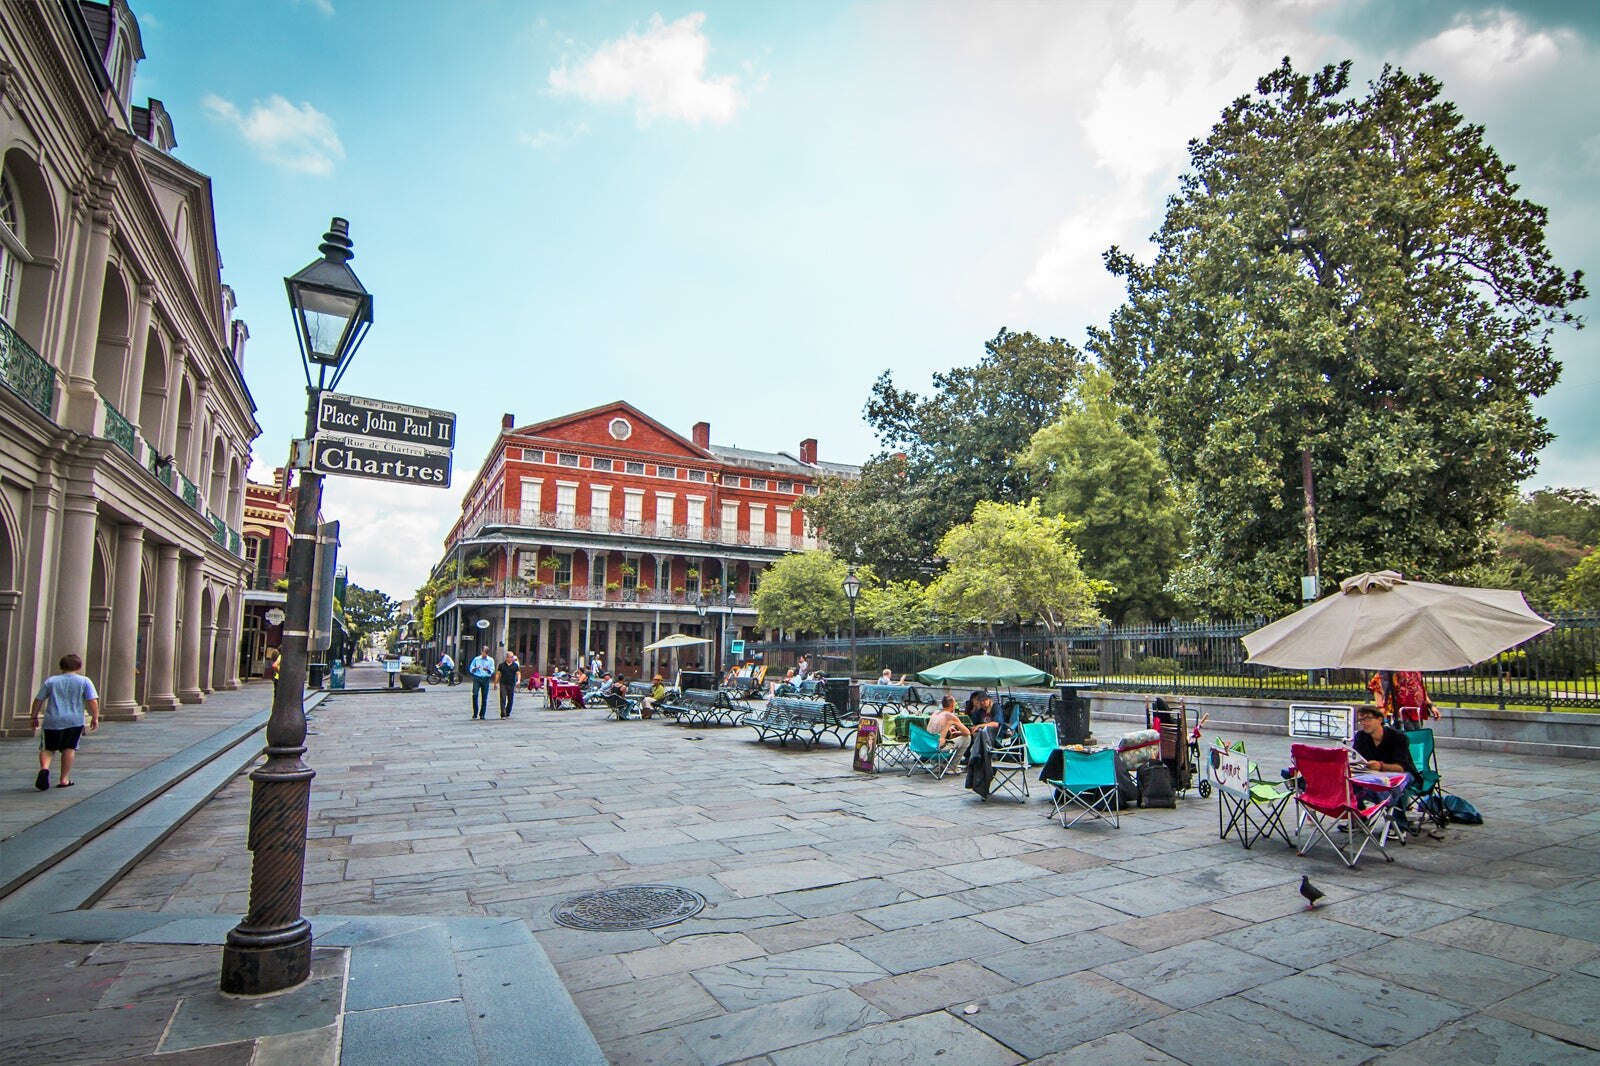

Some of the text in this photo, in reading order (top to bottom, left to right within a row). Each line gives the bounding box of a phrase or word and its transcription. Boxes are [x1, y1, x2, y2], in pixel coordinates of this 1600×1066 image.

[322, 404, 450, 440] Place John Paul II
[347, 438, 422, 456] Rue de Chartres
[321, 448, 444, 482] Chartres
